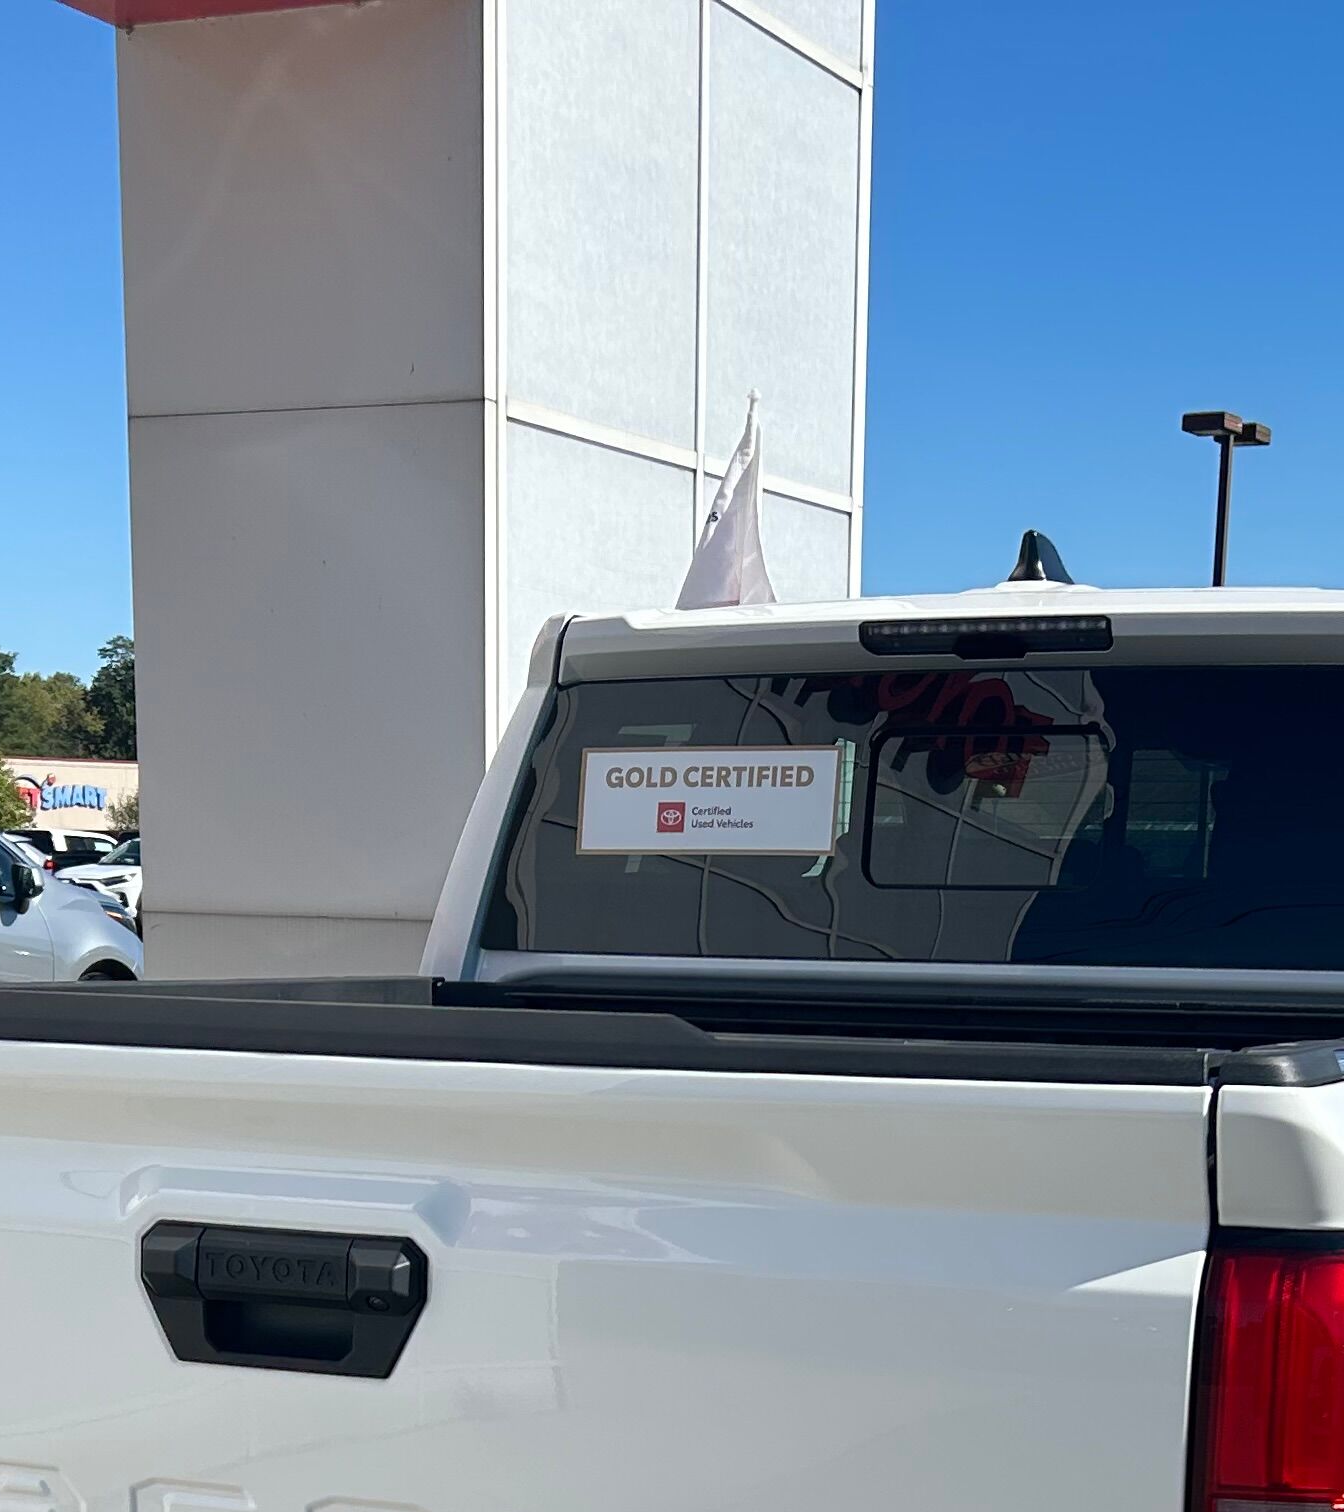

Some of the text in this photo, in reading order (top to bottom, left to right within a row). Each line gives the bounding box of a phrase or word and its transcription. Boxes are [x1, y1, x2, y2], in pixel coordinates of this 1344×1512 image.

[606, 766, 814, 788] GOLD CERTIFIED
[16, 784, 107, 811] ETSMART
[691, 806, 732, 816] Certified
[691, 818, 754, 829] Used Vehicles
[206, 1251, 336, 1288] TOYOTA
